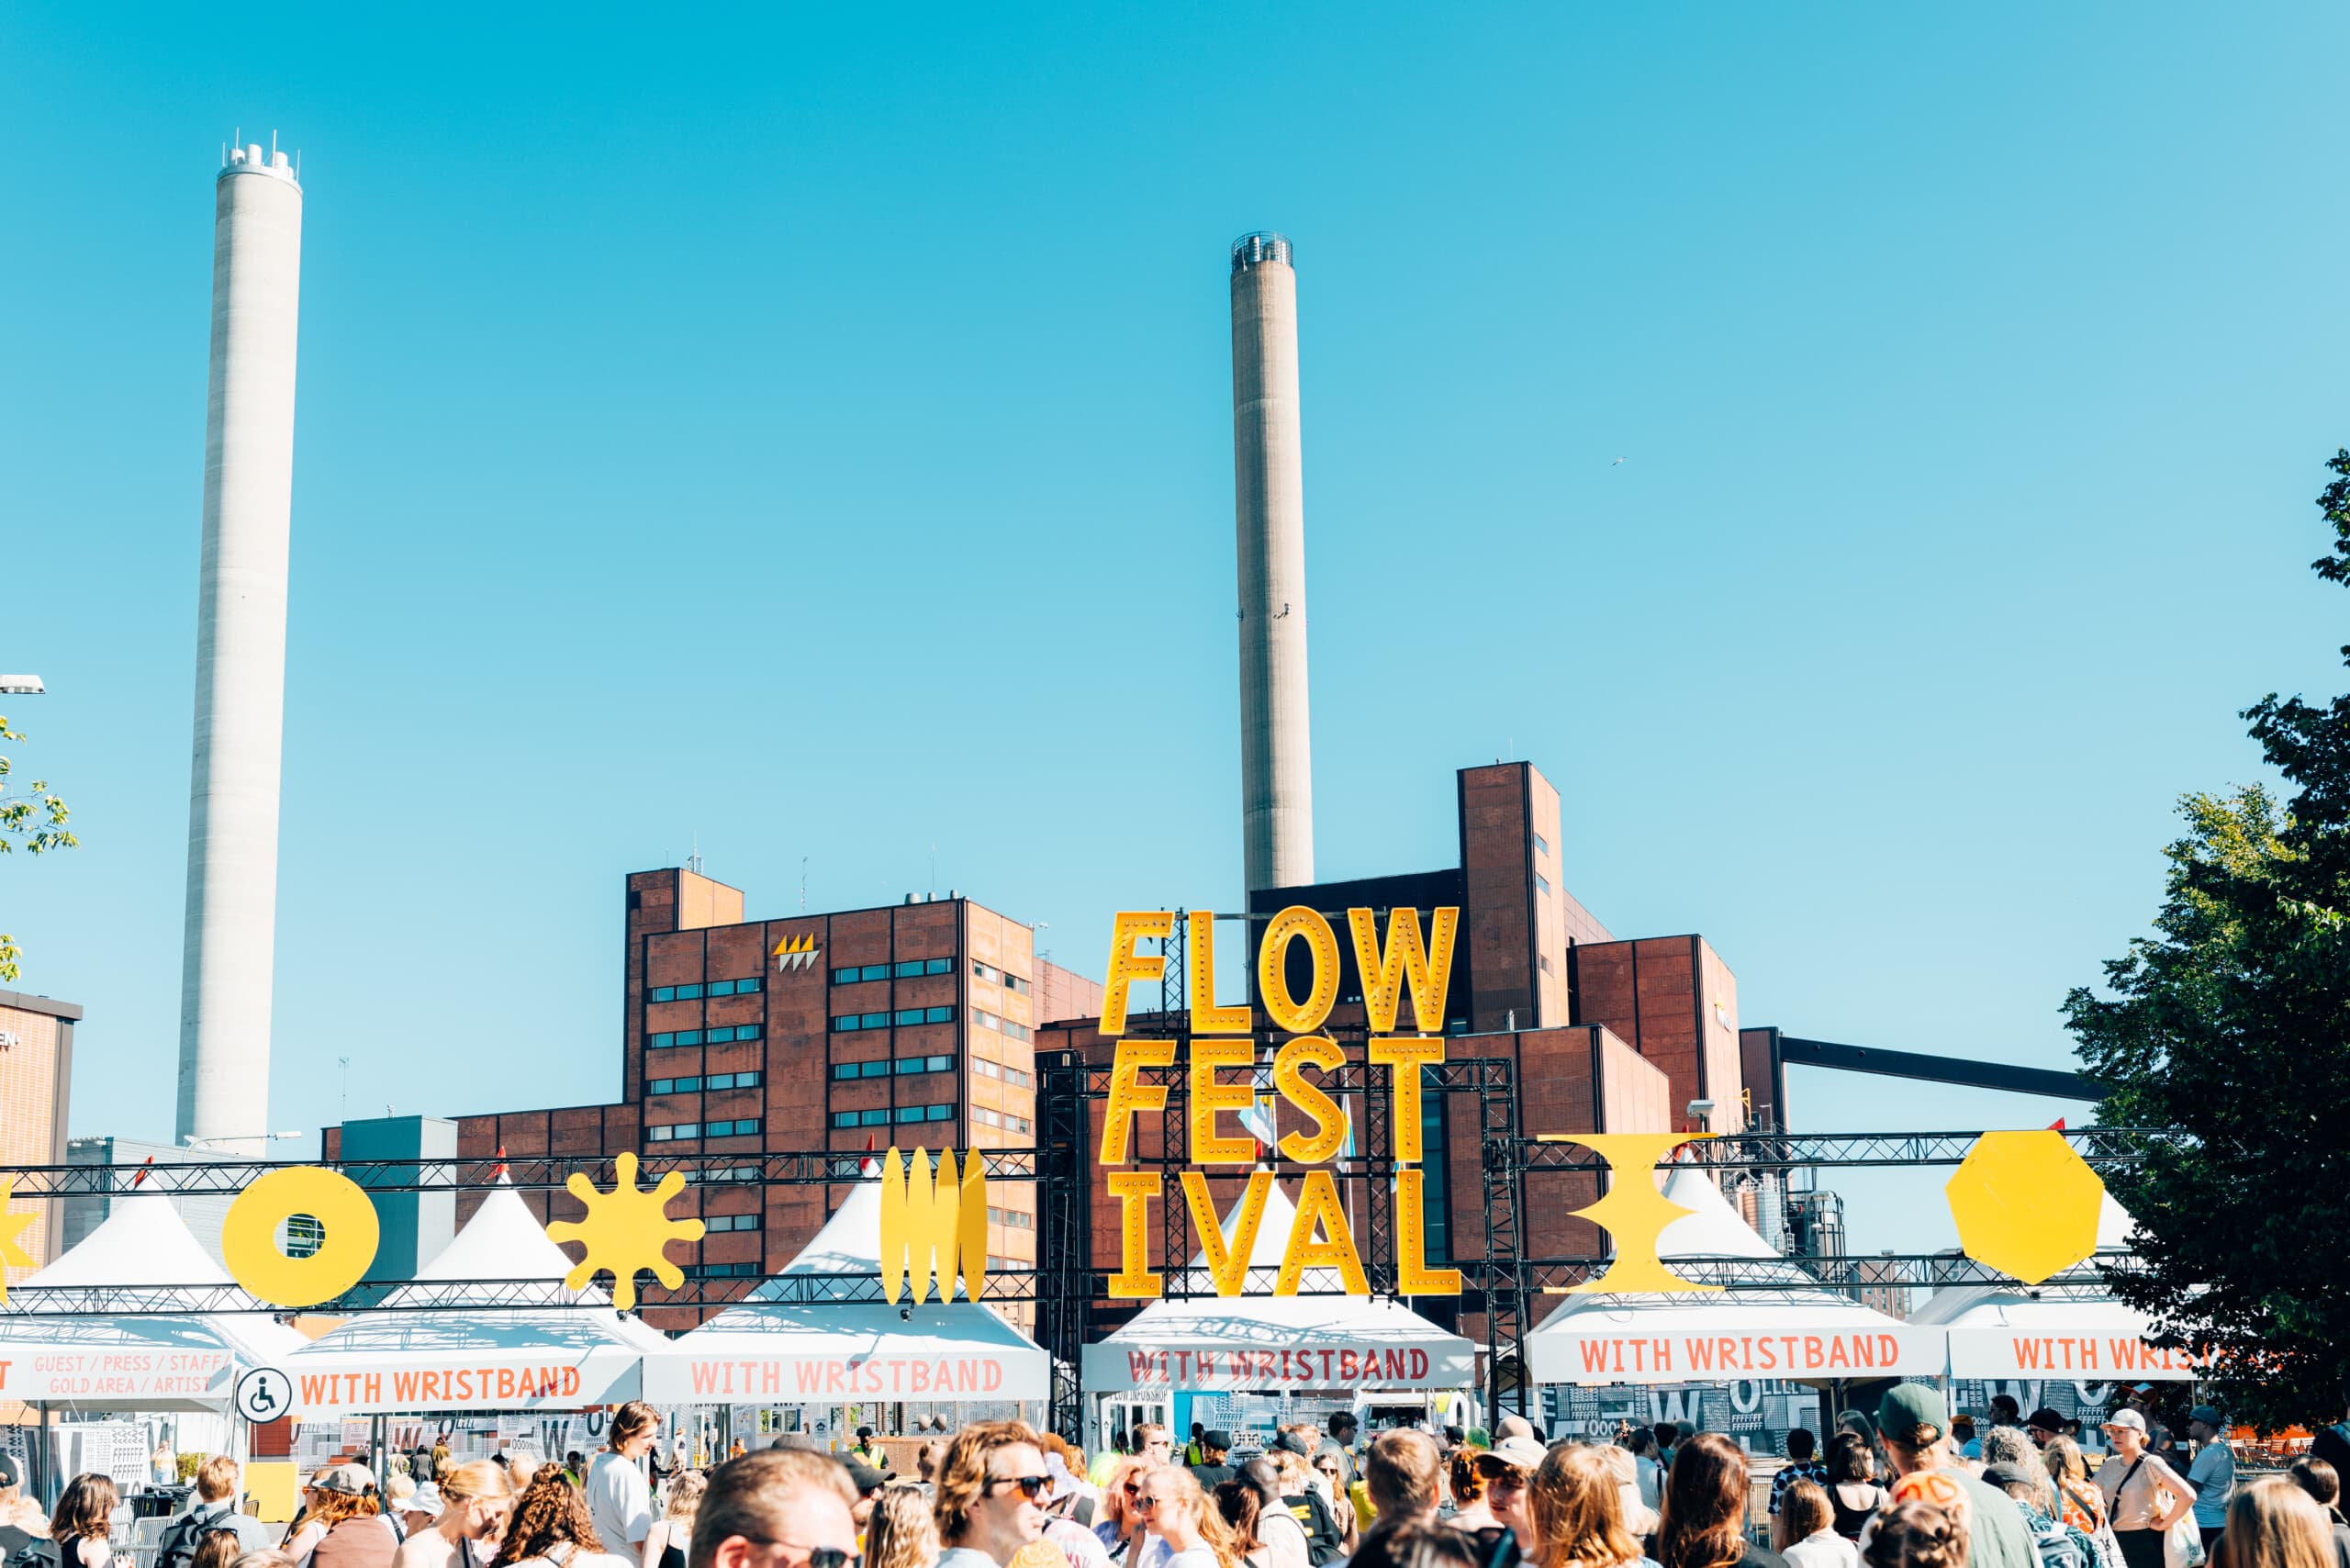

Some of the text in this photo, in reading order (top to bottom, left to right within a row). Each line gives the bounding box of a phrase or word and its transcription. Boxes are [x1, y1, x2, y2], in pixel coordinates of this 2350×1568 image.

[1098, 905, 1460, 1036] FLOW
[1098, 1036, 1445, 1166] FEST
[1107, 1169, 1461, 1298] IVAL
[35, 1356, 84, 1372] GUEST
[104, 1355, 151, 1372] PRESS
[1129, 1348, 1428, 1383] WITH WRISTBAND
[1580, 1334, 1898, 1373] WITH WRISTBAND
[2013, 1338, 2098, 1370] WITH
[50, 1378, 90, 1394] GOLD
[95, 1377, 135, 1394] AREA
[154, 1376, 211, 1393] ARTIST
[301, 1366, 580, 1406] WITH WRISTBAND
[691, 1359, 1002, 1395] WITH WRISTBAND
